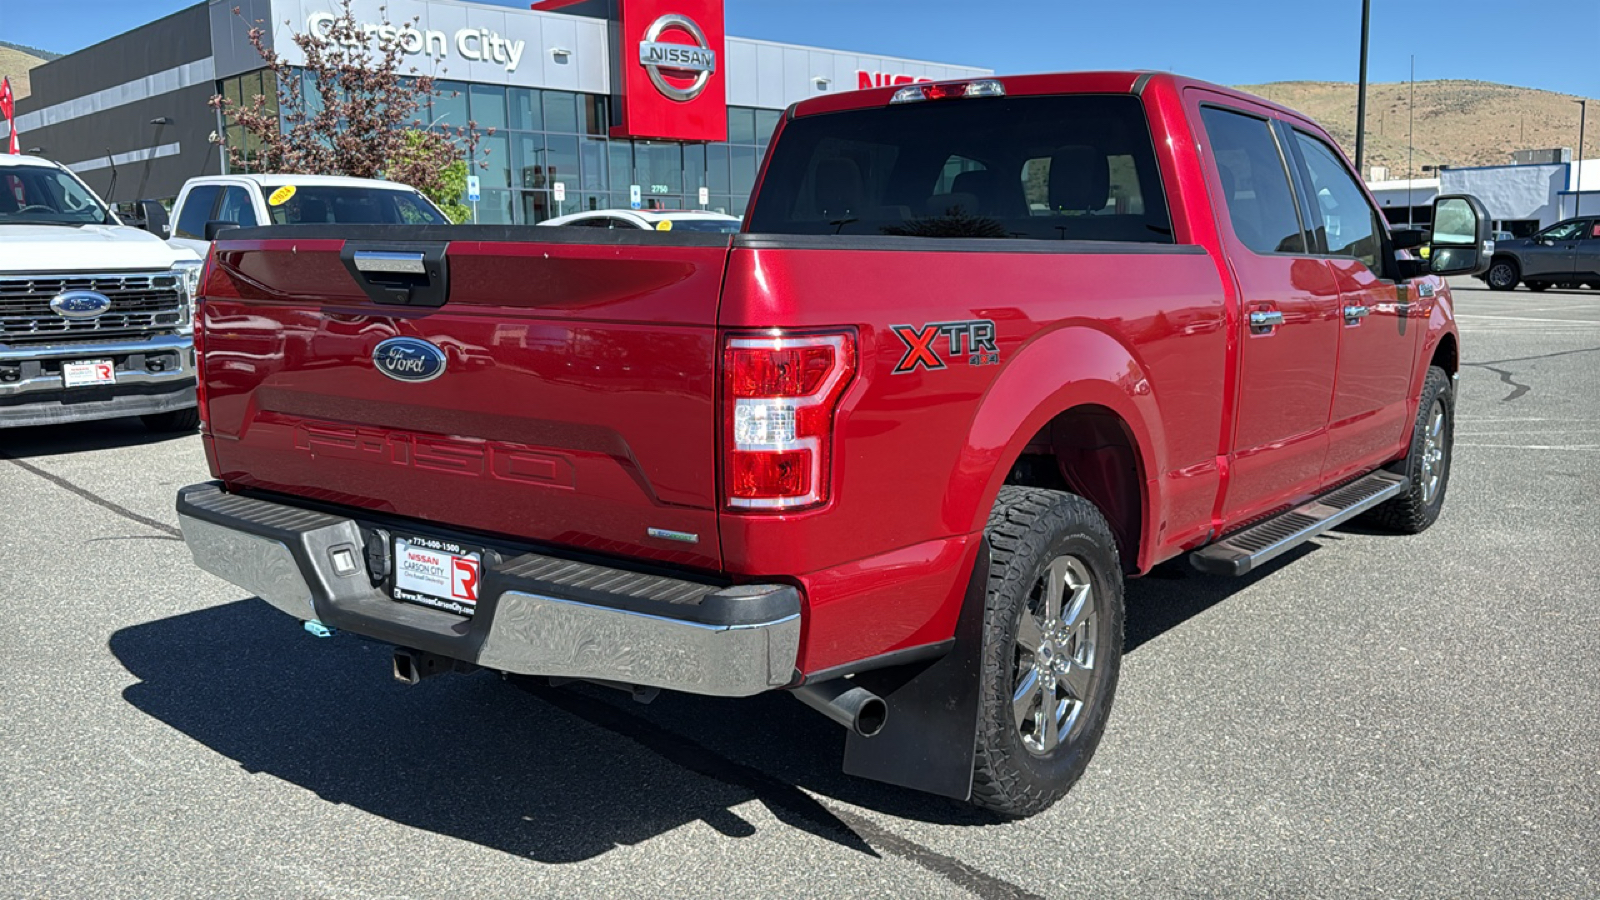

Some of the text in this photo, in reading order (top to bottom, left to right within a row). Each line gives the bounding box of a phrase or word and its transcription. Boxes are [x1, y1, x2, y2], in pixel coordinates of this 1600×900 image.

[306, 11, 525, 72] Carson City
[649, 46, 711, 67] NISSAN
[651, 184, 668, 194] 2750
[889, 319, 1000, 375] XTR
[385, 345, 426, 373] Ford
[403, 560, 445, 576] CARSON CITY
[408, 552, 440, 566] NISSAN
